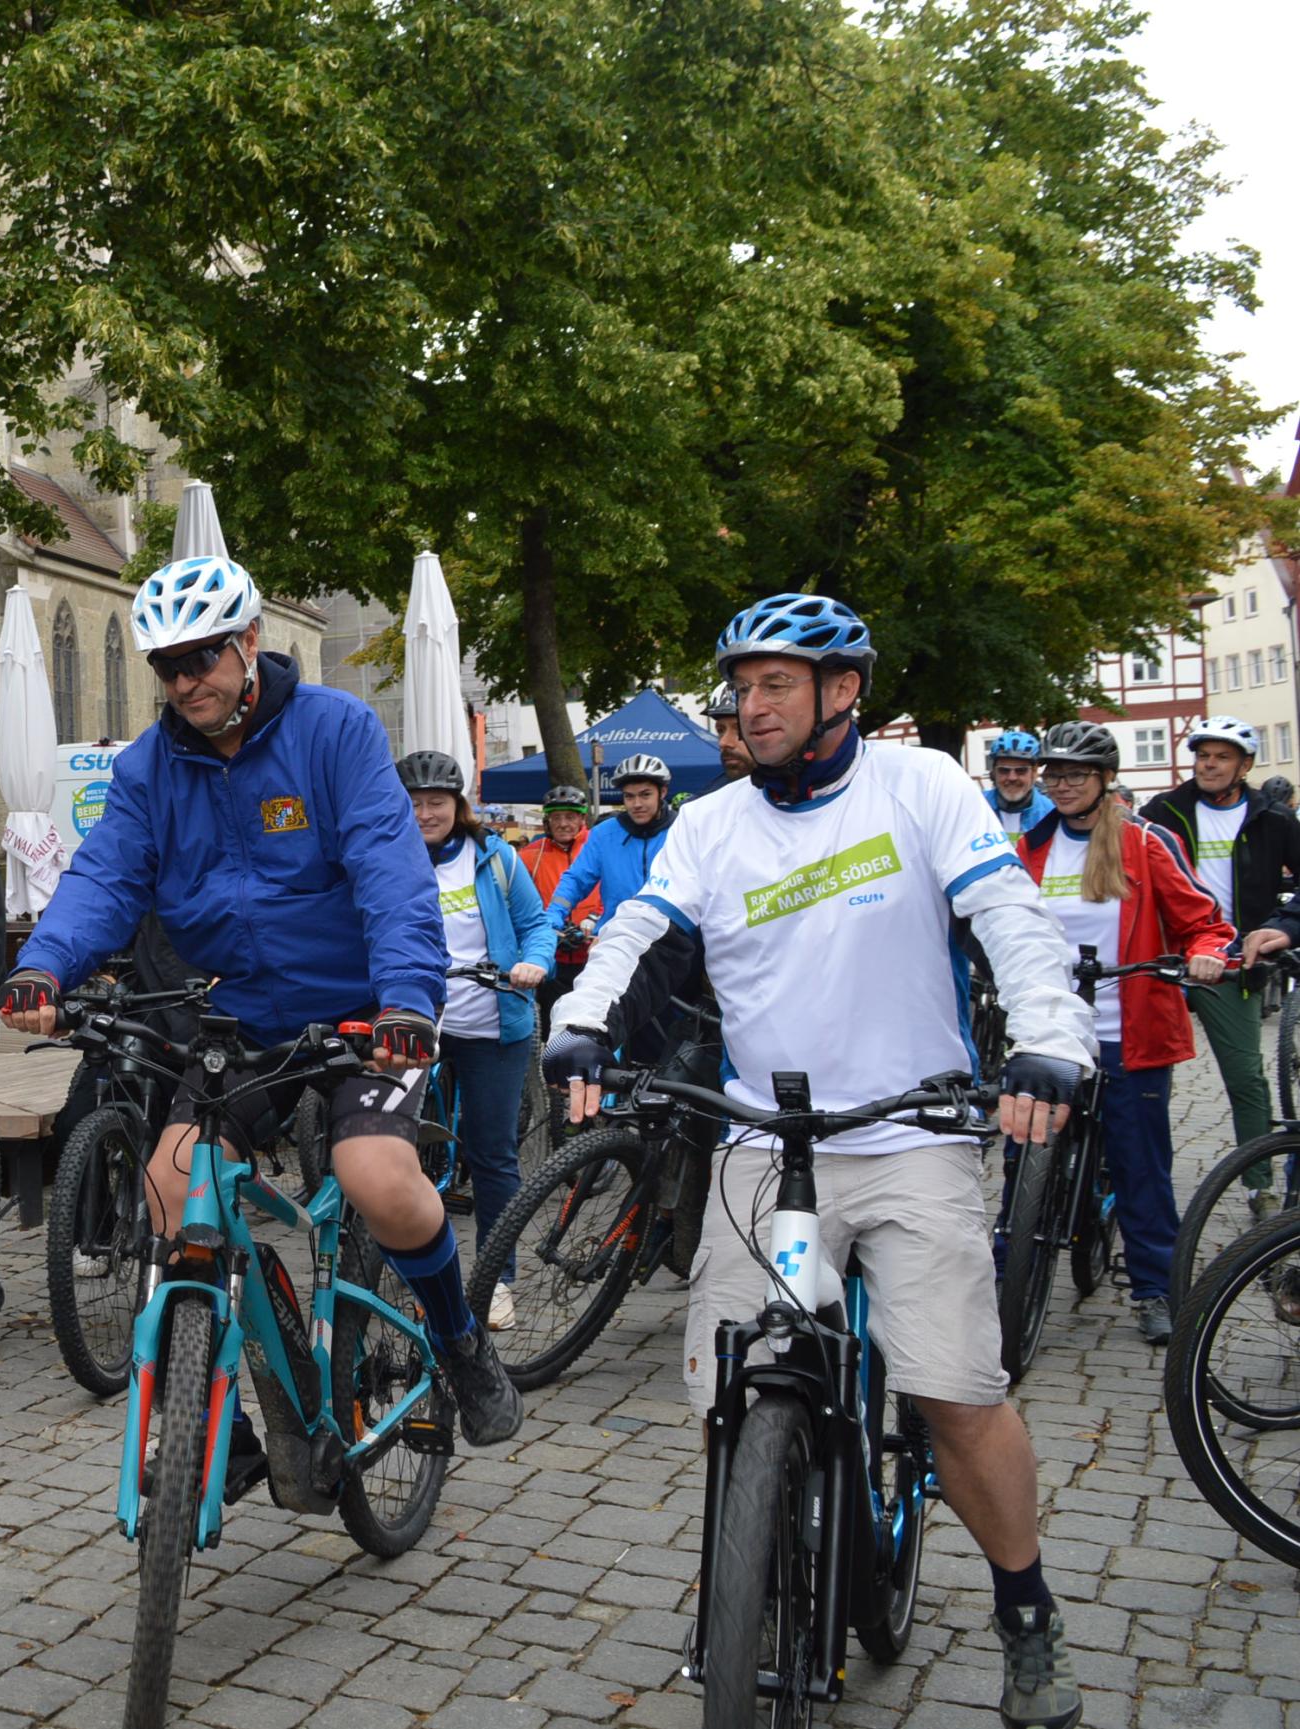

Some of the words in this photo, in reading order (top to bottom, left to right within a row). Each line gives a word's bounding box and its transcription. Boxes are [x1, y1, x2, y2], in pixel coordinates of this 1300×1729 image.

[70, 754, 113, 771] CSU
[970, 831, 1008, 852] CSU
[810, 865, 829, 881] mit
[777, 876, 839, 911] MARKUS
[840, 854, 894, 885] SÖDER
[848, 894, 873, 906] CSU
